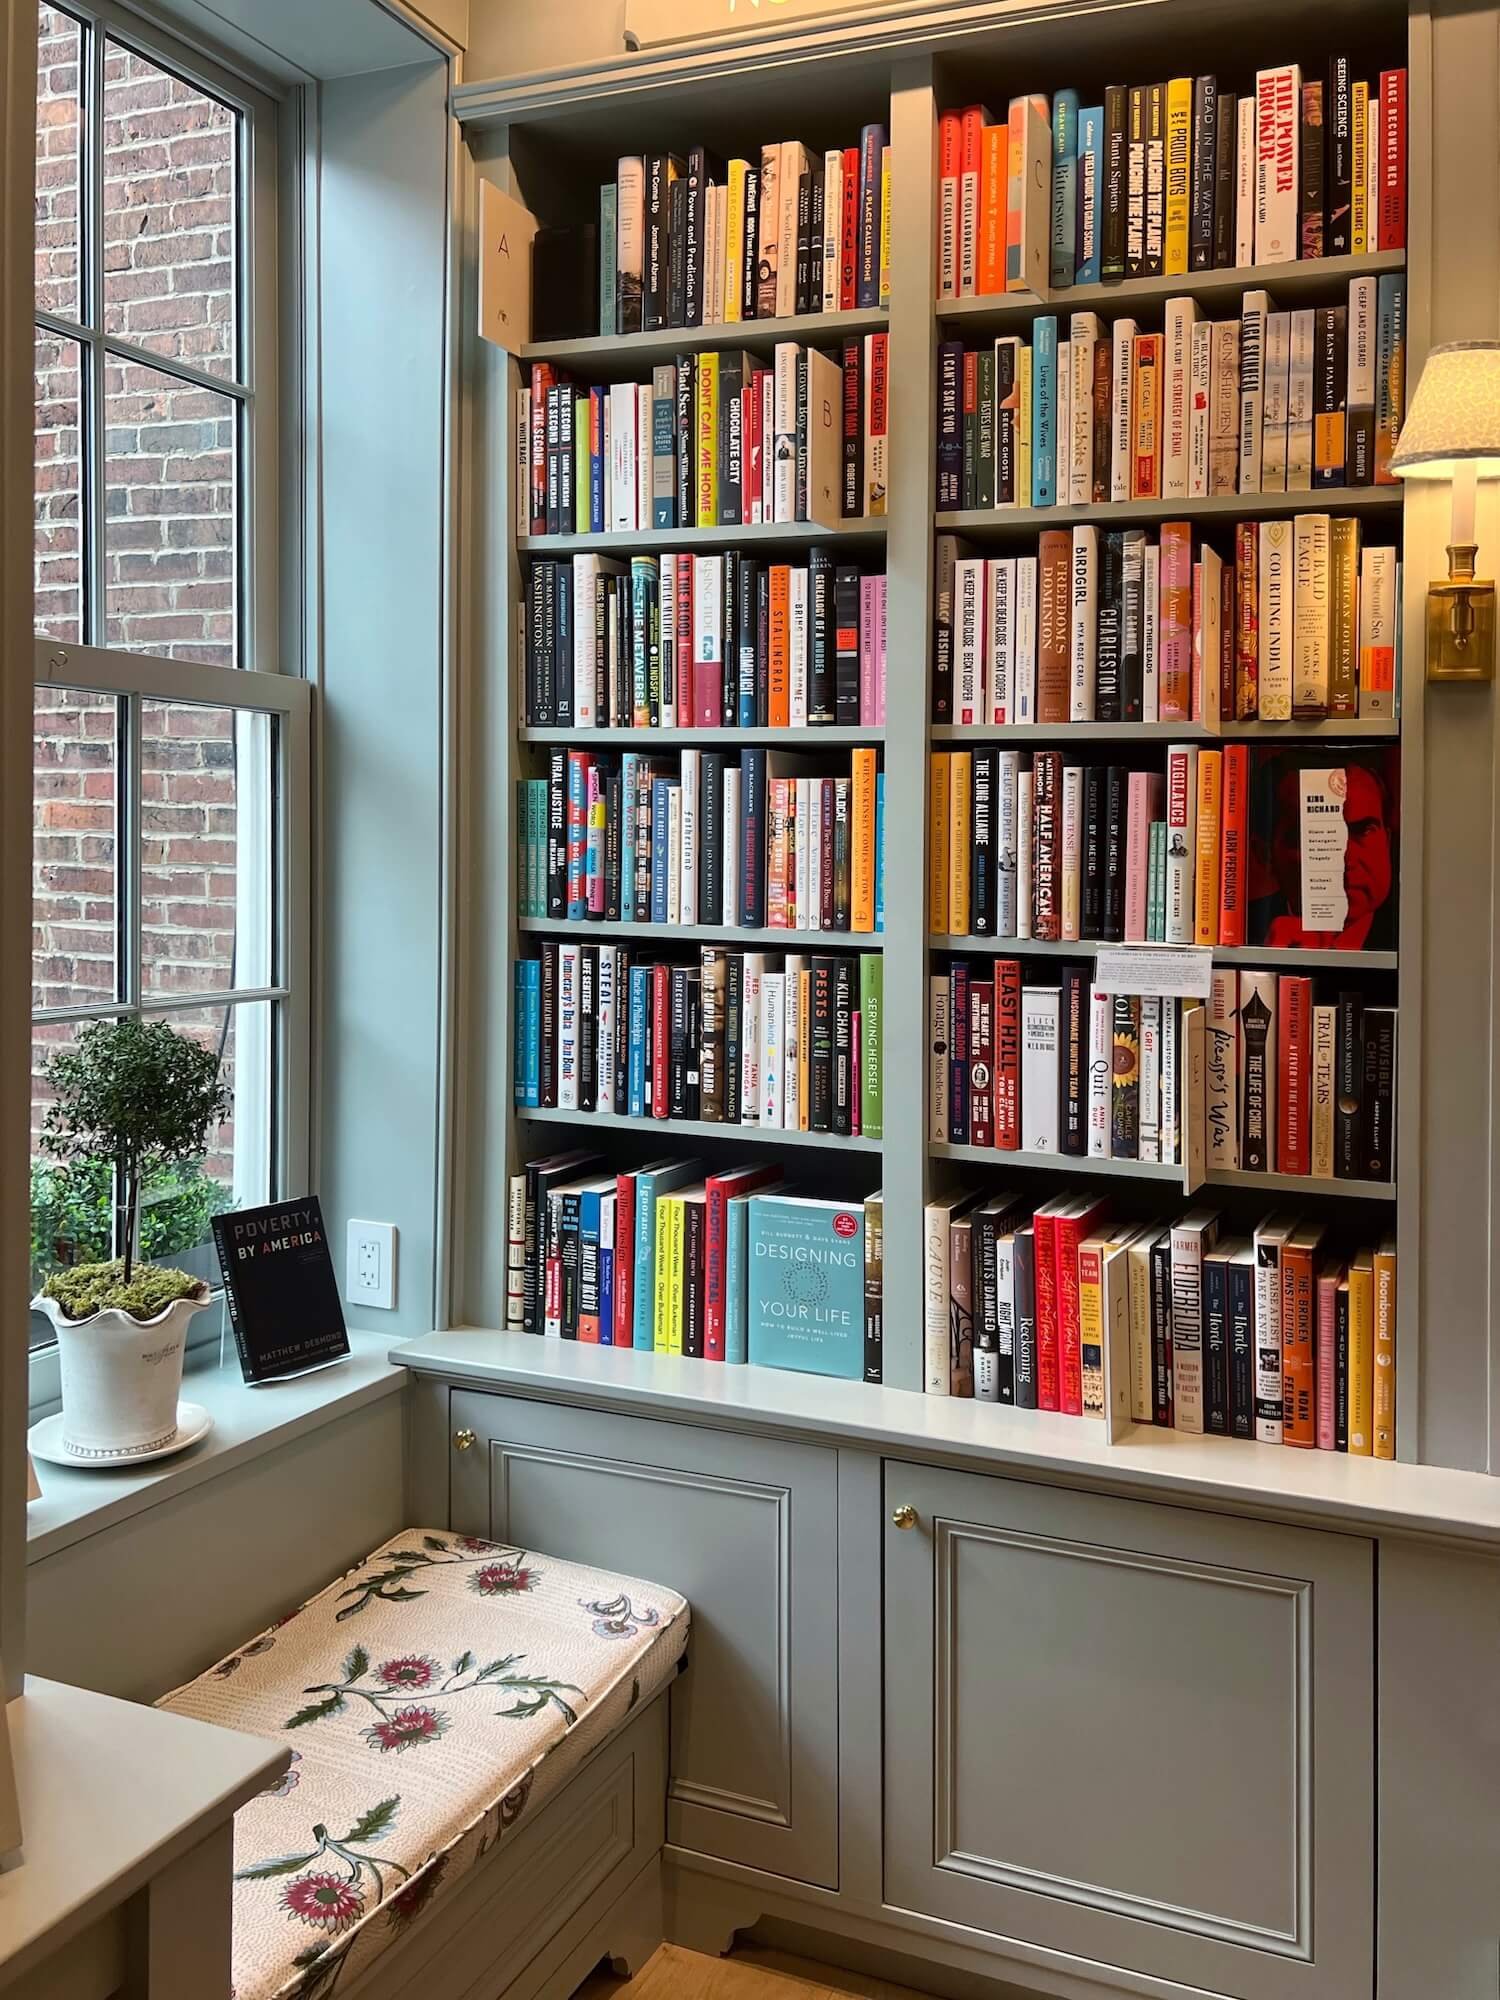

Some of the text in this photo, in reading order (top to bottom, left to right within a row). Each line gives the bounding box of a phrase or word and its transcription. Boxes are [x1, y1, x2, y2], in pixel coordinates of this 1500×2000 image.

[1058, 103, 1066, 130] SUSAN
[1259, 78, 1275, 161] BROKER
[1277, 70, 1293, 193] THE POWER
[1387, 76, 1397, 187] RAGE BECOMES HER
[651, 160, 660, 213] The Come Up
[1108, 133, 1122, 213] Planta Sapiens
[1170, 128, 1187, 195] PROUD BOYS
[687, 191, 696, 223] Power
[1055, 164, 1069, 248] Bittersweet
[1147, 141, 1163, 257] POLICING THE PLANET
[497, 233, 510, 260] A
[651, 225, 659, 293] Jonathan Abrams
[687, 245, 695, 297] Prediction
[944, 359, 955, 387] CAN'T
[1241, 311, 1260, 392] BLACK SKINHEAD
[561, 388, 570, 441] THE SECOND
[679, 362, 690, 416] Bad Sex
[823, 400, 831, 427] B
[845, 346, 858, 436] THE FOURTH MAN
[873, 340, 885, 429] THE NEW GUYS
[943, 390, 955, 413] SAVE
[1039, 366, 1049, 448] Lives of the Wives
[701, 368, 711, 512] DON'T CALL ME HOME
[730, 398, 740, 483] CHOCOLATE CITY
[943, 415, 955, 433] YOU
[981, 400, 991, 458] TASTES LIKE WAR
[846, 464, 855, 509] ROBERT BAER
[1076, 547, 1087, 606] BIRDGIRL
[1123, 541, 1140, 582] THE YANK
[1298, 536, 1310, 588] EAGLE
[1314, 523, 1326, 600] THE BALD
[534, 566, 543, 647] WASHINGTON
[596, 578, 605, 636] JAMES BALDWIN
[678, 561, 690, 637] IN THE BLOOD
[815, 574, 825, 618] GENEALOGY
[815, 620, 824, 629] OF
[1043, 567, 1053, 649] DOMINION
[1056, 561, 1067, 654] FREEDOM'S
[1269, 553, 1281, 671] COURTING INDIA
[634, 600, 644, 706] THE METAVERSE
[650, 656, 658, 702] BLINDSPOT
[740, 647, 753, 696] COMPLICIT
[773, 611, 783, 693] STALINGRAD
[815, 641, 824, 674] MURDER
[938, 630, 948, 671] RISING
[1099, 609, 1117, 694] CHARLESTON
[551, 756, 562, 829] VIRAL JUSTICE
[836, 784, 846, 822] WILDCAT
[976, 760, 989, 845] THE LONG ALLIANCE
[1171, 759, 1184, 824] VIGILANCE
[1040, 805, 1052, 916] HALF AMERICAN
[1224, 830, 1237, 911] DARK PERSUASION
[582, 959, 591, 1014] LIFE SENTENCE
[600, 963, 611, 1005] STEAL
[816, 970, 827, 1018] PESTS
[837, 983, 848, 1007] KILL
[561, 954, 575, 1080] Democracy's Data Dan Bouk
[767, 990, 777, 1045] Humankind
[837, 1011, 848, 1047] CHAIN
[868, 998, 877, 1097] SERVING HERSELF
[1001, 973, 1016, 1072] LAST HILL
[1091, 1060, 1108, 1097] Quit
[1206, 1028, 1235, 1148] Picasso's War
[1249, 1055, 1262, 1139] THE LIFE OF CRIME
[238, 1232, 321, 1260] BY AMERICA
[640, 1185, 651, 1242] Ignorance
[672, 1207, 680, 1221] Four
[755, 1242, 856, 1268] DESIGNING
[928, 1235, 942, 1303] CAUSE
[983, 1224, 995, 1331] SERVANTS DAMNED
[760, 1300, 851, 1325] YOUR LIFE
[999, 1302, 1012, 1355] RIGHT WRONG
[1174, 1263, 1201, 1351] ELDERFLORA
[1285, 1267, 1294, 1345] CONSTITUTION
[1299, 1275, 1308, 1342] THE BROKEN
[1379, 1270, 1390, 1340] Moonbound
[1020, 1318, 1033, 1383] Reckoning
[1285, 1376, 1293, 1430] FELDMAN
[1299, 1390, 1308, 1420] NOAH
